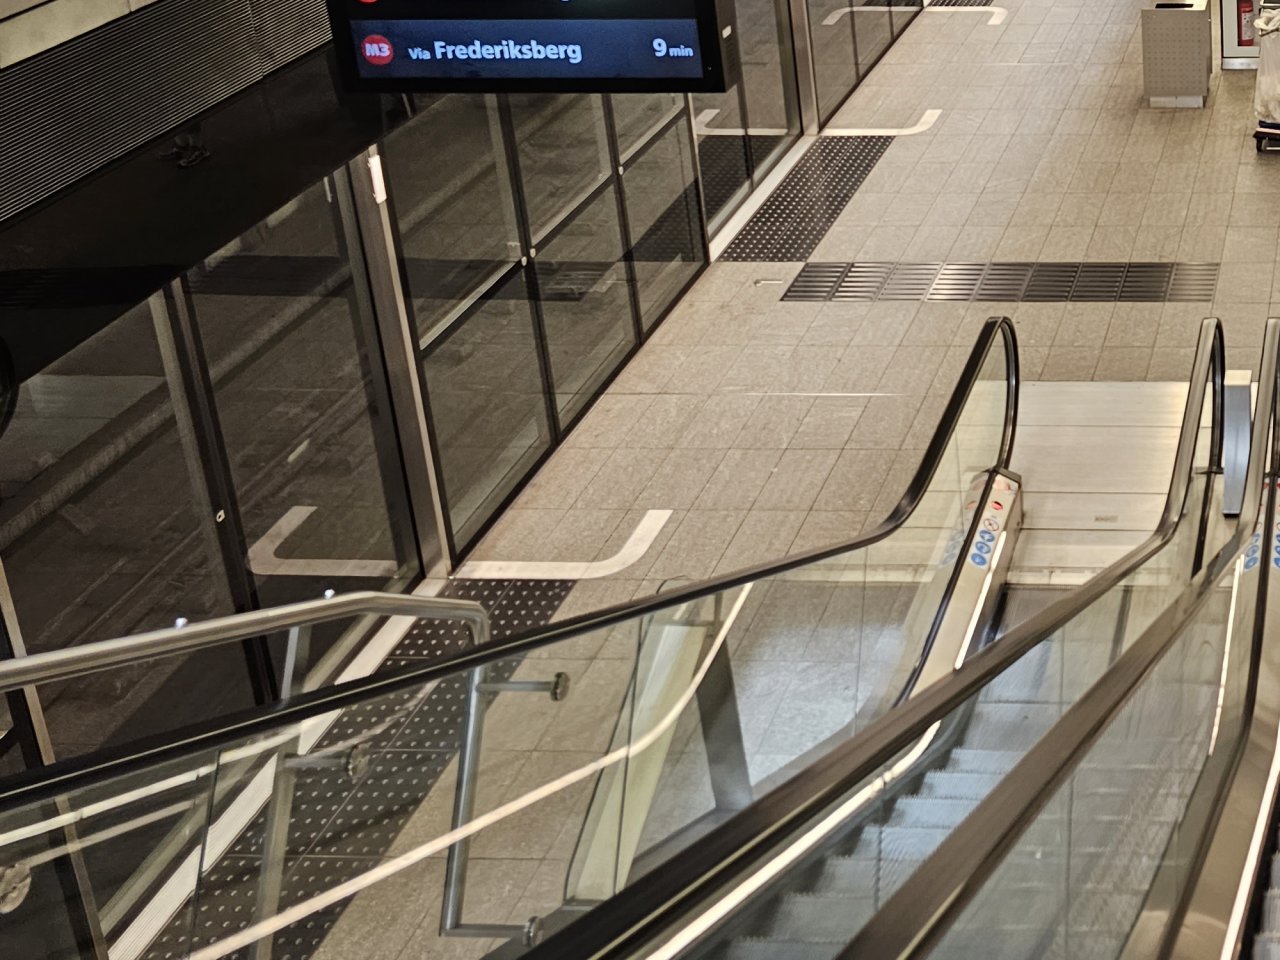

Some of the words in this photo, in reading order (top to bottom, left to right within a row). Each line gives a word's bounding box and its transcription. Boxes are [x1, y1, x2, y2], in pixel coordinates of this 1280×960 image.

[365, 42, 391, 57] M3
[407, 47, 432, 60] Via
[433, 39, 583, 64] Frederiksberg
[652, 38, 667, 58] 9
[668, 44, 694, 58] min
